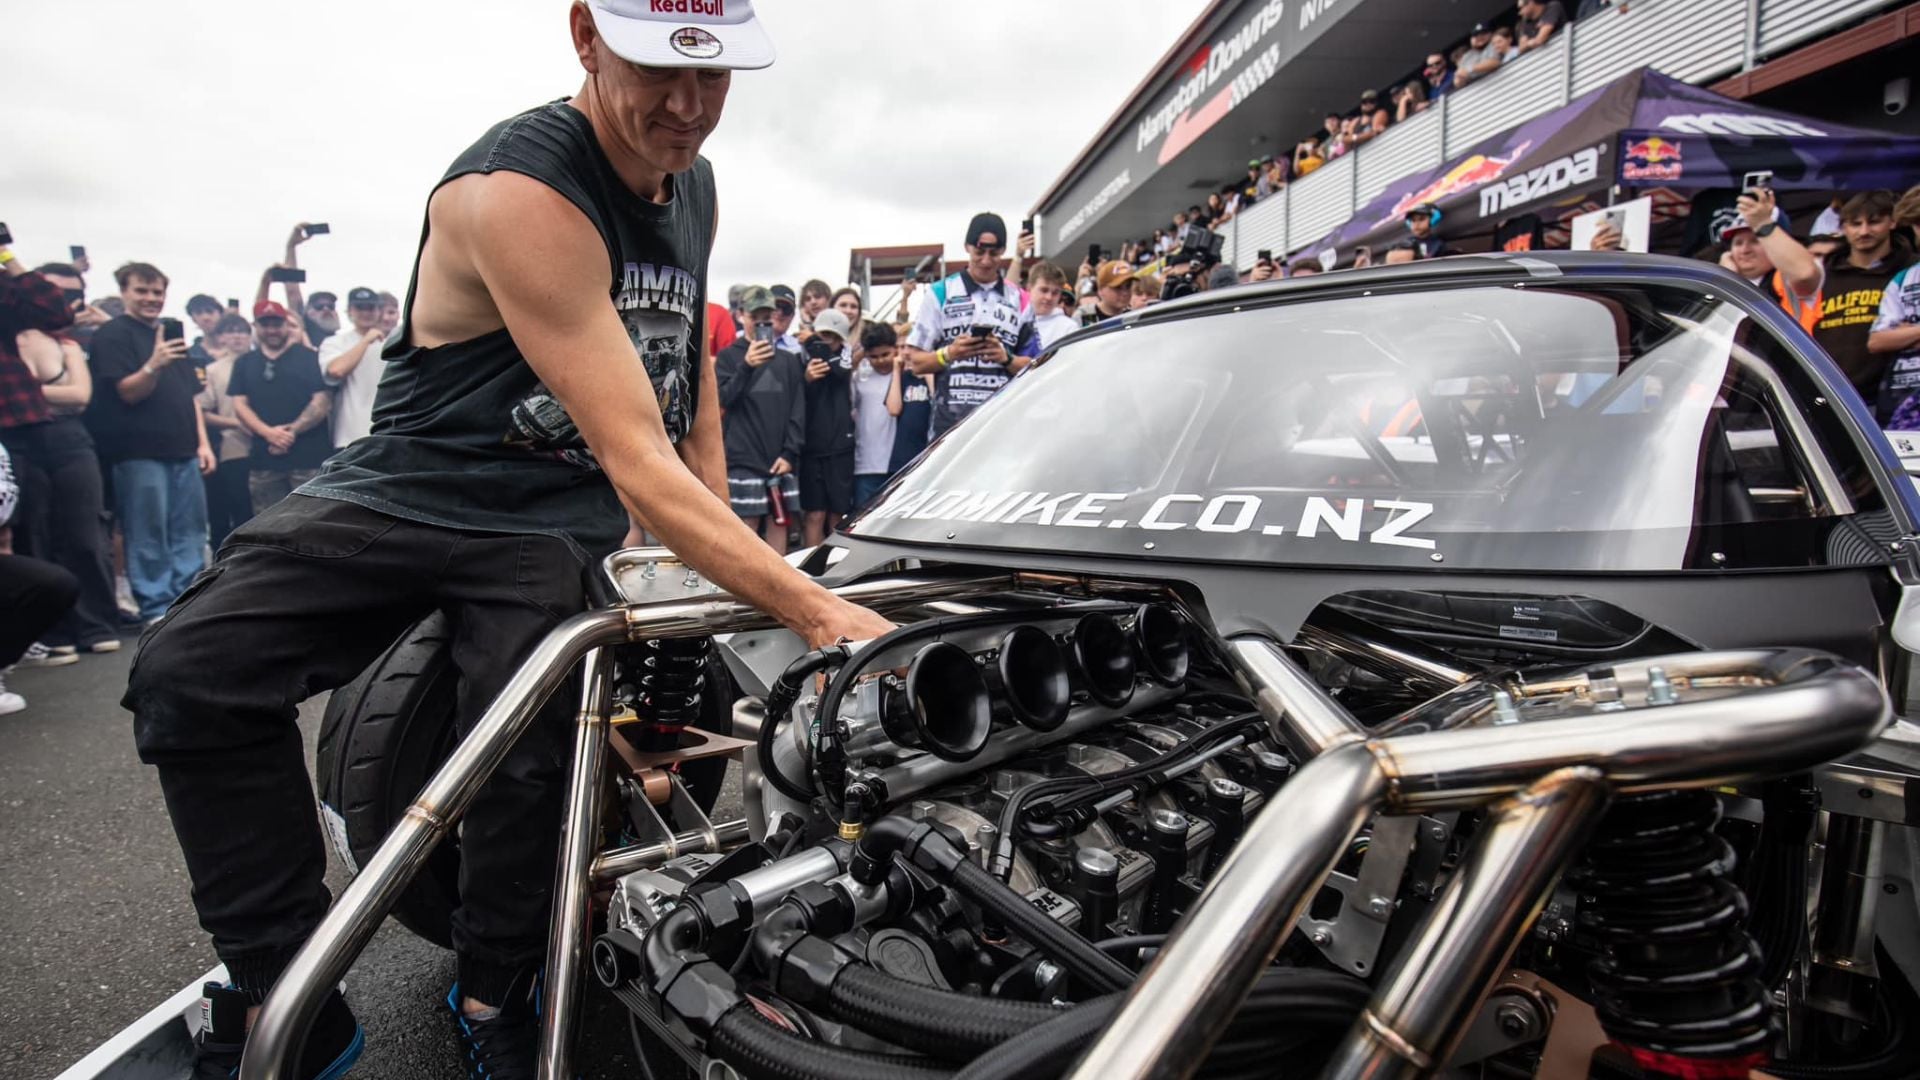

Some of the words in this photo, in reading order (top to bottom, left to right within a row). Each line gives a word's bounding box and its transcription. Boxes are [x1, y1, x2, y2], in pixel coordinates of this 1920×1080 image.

[650, 0, 688, 13] Red
[691, 0, 724, 16] Bull
[1137, 67, 1208, 152] Hampton
[1207, 0, 1284, 86] Downs
[1822, 289, 1887, 315] ALIFOR
